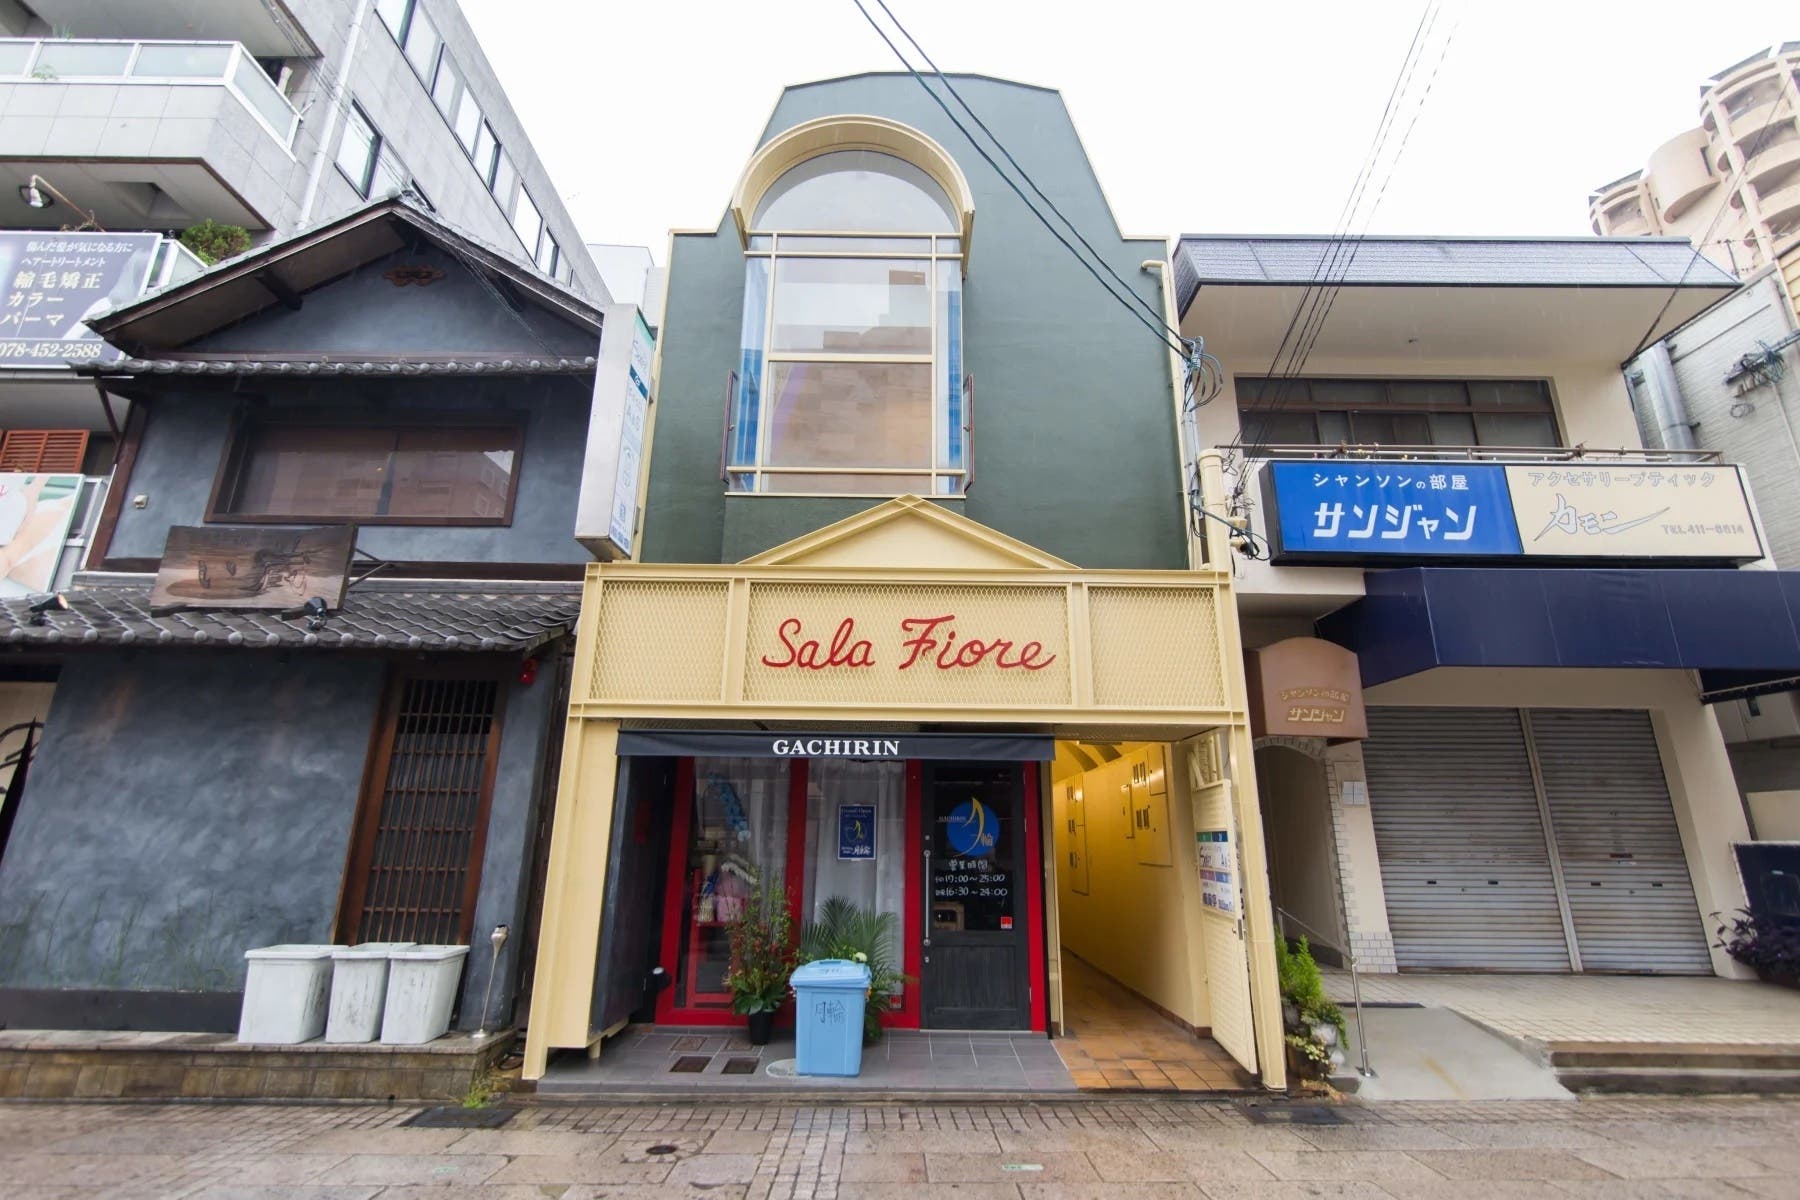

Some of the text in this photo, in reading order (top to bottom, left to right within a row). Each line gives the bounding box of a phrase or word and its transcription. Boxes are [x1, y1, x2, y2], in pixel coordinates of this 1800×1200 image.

[22, 256, 106, 267] ヘアートリートメント
[8, 291, 64, 308] カラー
[1312, 473, 1469, 491] シャンソンの部屋
[1313, 502, 1477, 541] サンジャン
[761, 614, 1057, 671] Sala Fiore
[1287, 707, 1345, 722] サンジャン
[772, 739, 900, 756] GACHIRIN
